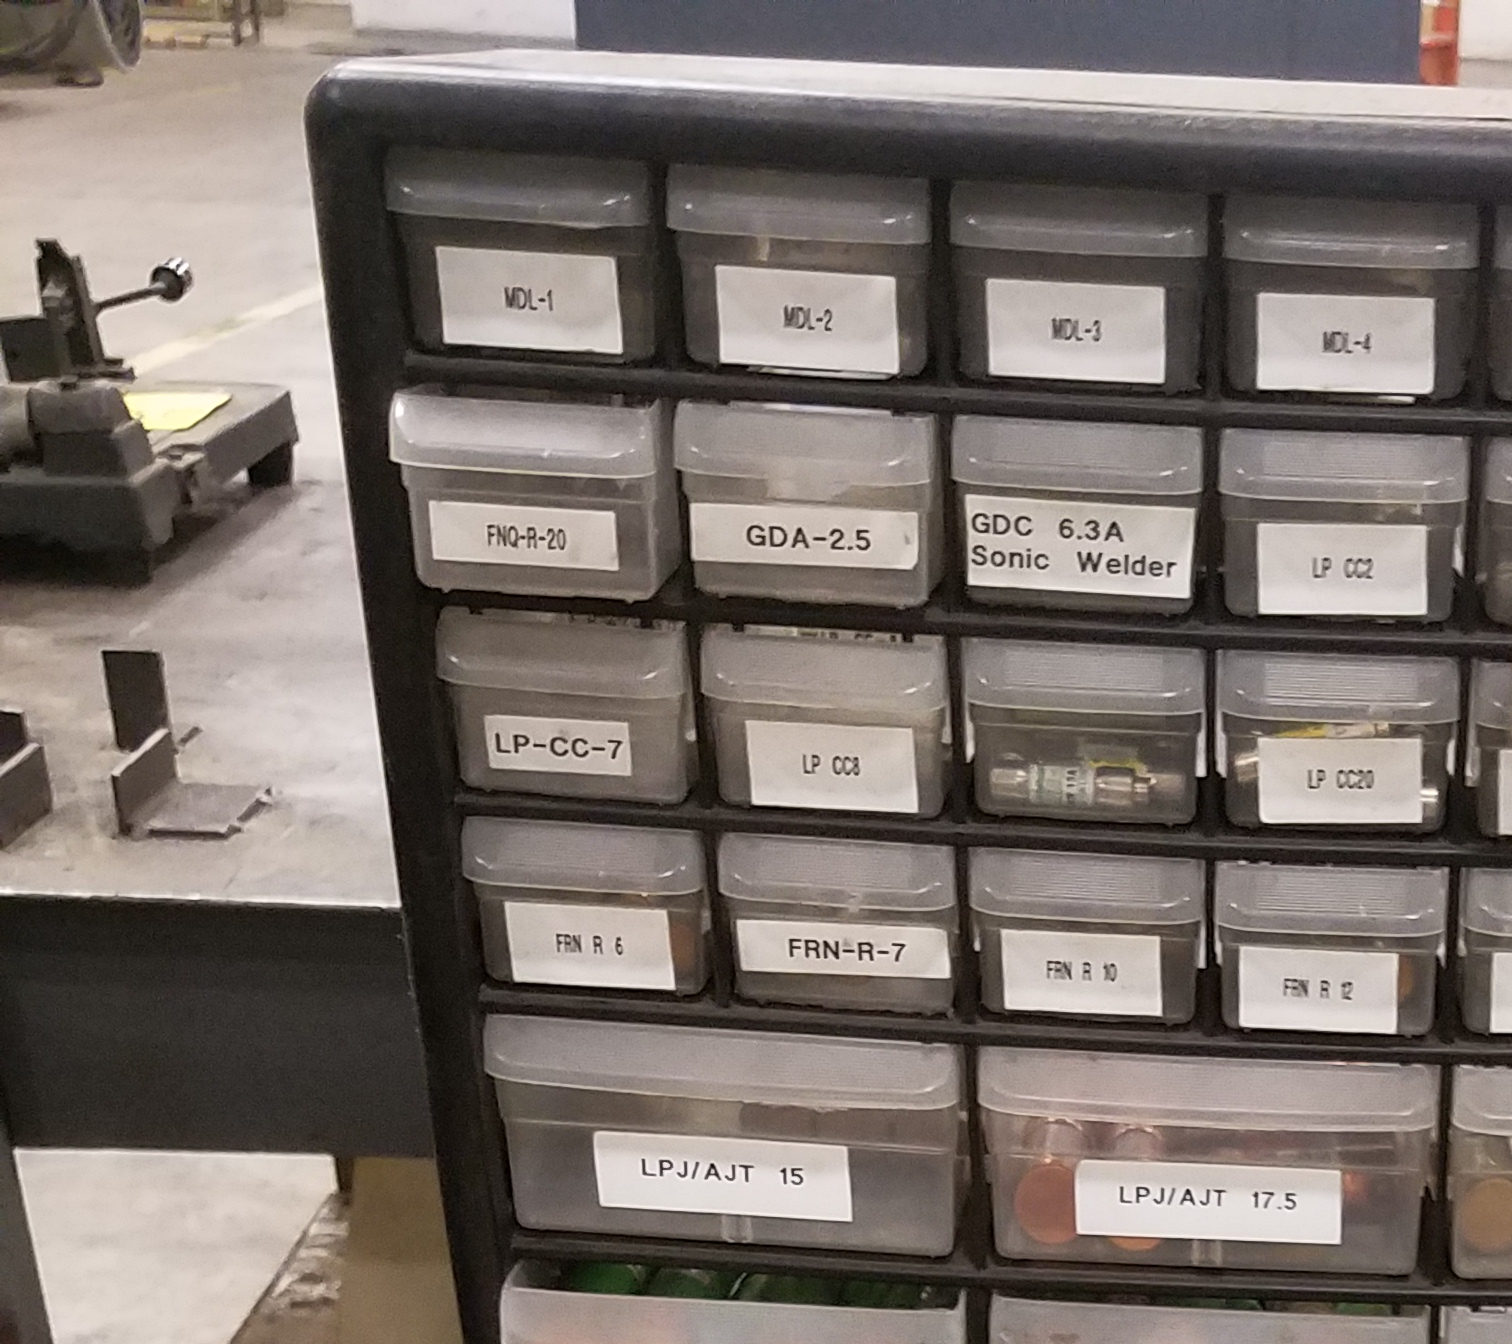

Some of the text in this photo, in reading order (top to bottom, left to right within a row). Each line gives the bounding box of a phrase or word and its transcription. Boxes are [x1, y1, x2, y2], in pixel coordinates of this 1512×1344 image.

[504, 287, 553, 311] MDL-1
[784, 305, 832, 331] MDL-2
[1051, 318, 1101, 342] MDL-3
[1322, 331, 1371, 354] MDL-4
[487, 524, 566, 550] FNQ-R-20
[746, 525, 871, 551] GDA-2.5
[971, 513, 1124, 542] GDC 6.3A
[971, 545, 1177, 577] Sonic Welder
[1313, 557, 1373, 579] LP CC2
[495, 730, 623, 759] LP-CC-7
[803, 754, 860, 776] LP CC8
[1308, 769, 1374, 789] LP CC20
[556, 934, 623, 955] FRN R 6
[789, 939, 906, 962] FRN-R-7
[1047, 961, 1117, 982] FRN R 10
[1284, 978, 1353, 1000] FRN R 12
[641, 1158, 803, 1185] LPJ/AJT 15
[1120, 1186, 1296, 1210] LPJ/AJT 17.5
